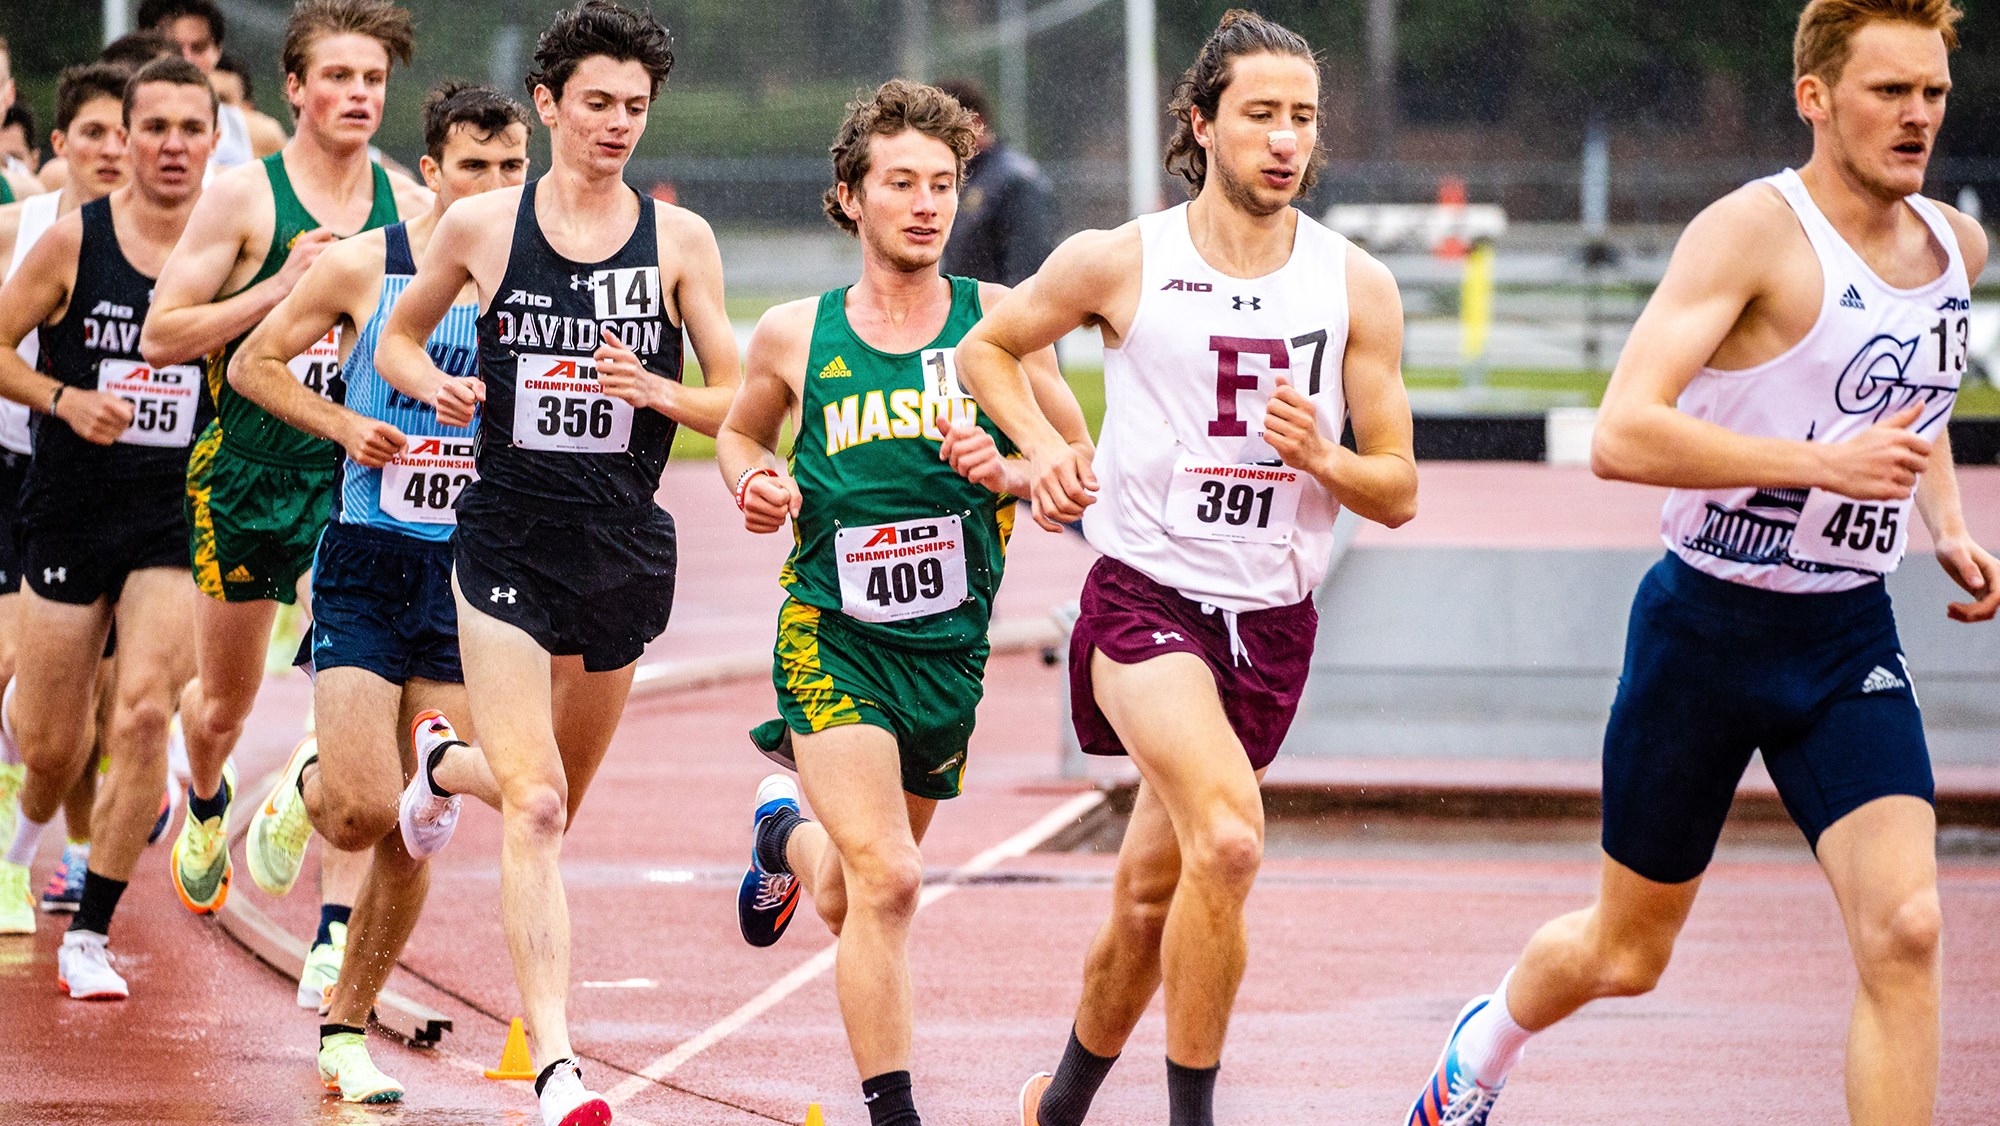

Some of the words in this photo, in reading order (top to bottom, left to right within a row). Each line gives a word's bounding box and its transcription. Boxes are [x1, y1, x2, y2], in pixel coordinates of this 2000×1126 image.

[504, 290, 552, 308] A10
[598, 270, 651, 315] 14
[1160, 279, 1213, 293] A10
[91, 301, 133, 319] A10
[83, 317, 142, 354] DAV
[1930, 317, 1968, 372] 13
[124, 367, 182, 384] A10
[820, 369, 852, 379] adidas
[1290, 329, 1328, 396] 7
[106, 382, 192, 397] CHAMPIONSHIPS
[1208, 335, 1290, 437] F
[537, 395, 614, 438] 356
[823, 389, 977, 456] MASON
[410, 439, 474, 457] A10
[404, 472, 473, 510] 482
[1197, 480, 1274, 528] 391
[862, 525, 938, 548] A10
[1822, 502, 1900, 554] 455
[846, 540, 955, 563] CHAMPIONSHIPS
[866, 557, 944, 607] 409
